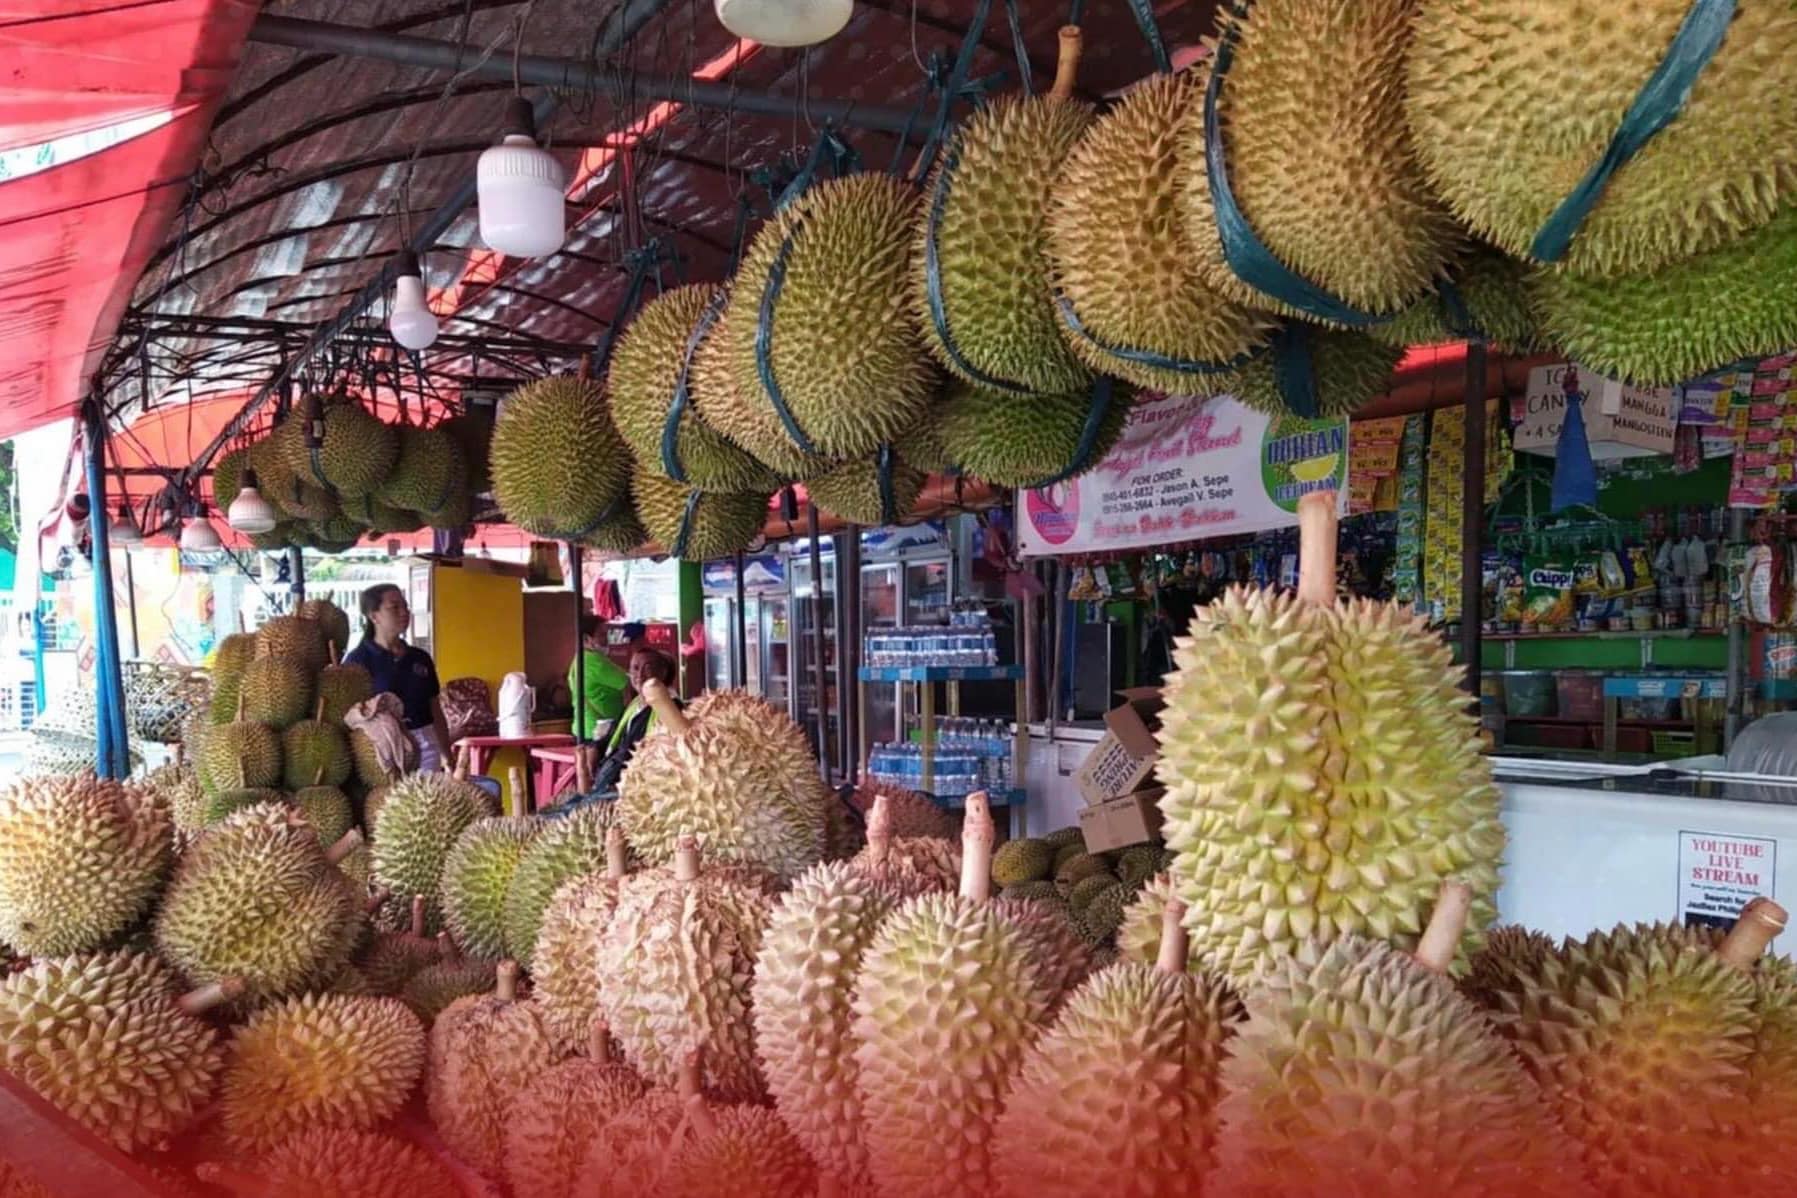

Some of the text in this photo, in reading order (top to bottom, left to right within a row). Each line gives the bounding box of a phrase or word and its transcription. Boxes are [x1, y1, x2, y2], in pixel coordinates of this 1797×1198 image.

[1528, 389, 1591, 414] CANY
[1203, 474, 1230, 488] Sepe
[1207, 486, 1234, 501] Sepe
[1692, 839, 1763, 857] YOUTUBE
[1709, 854, 1744, 869] LIVE
[1692, 867, 1760, 886] STREAM
